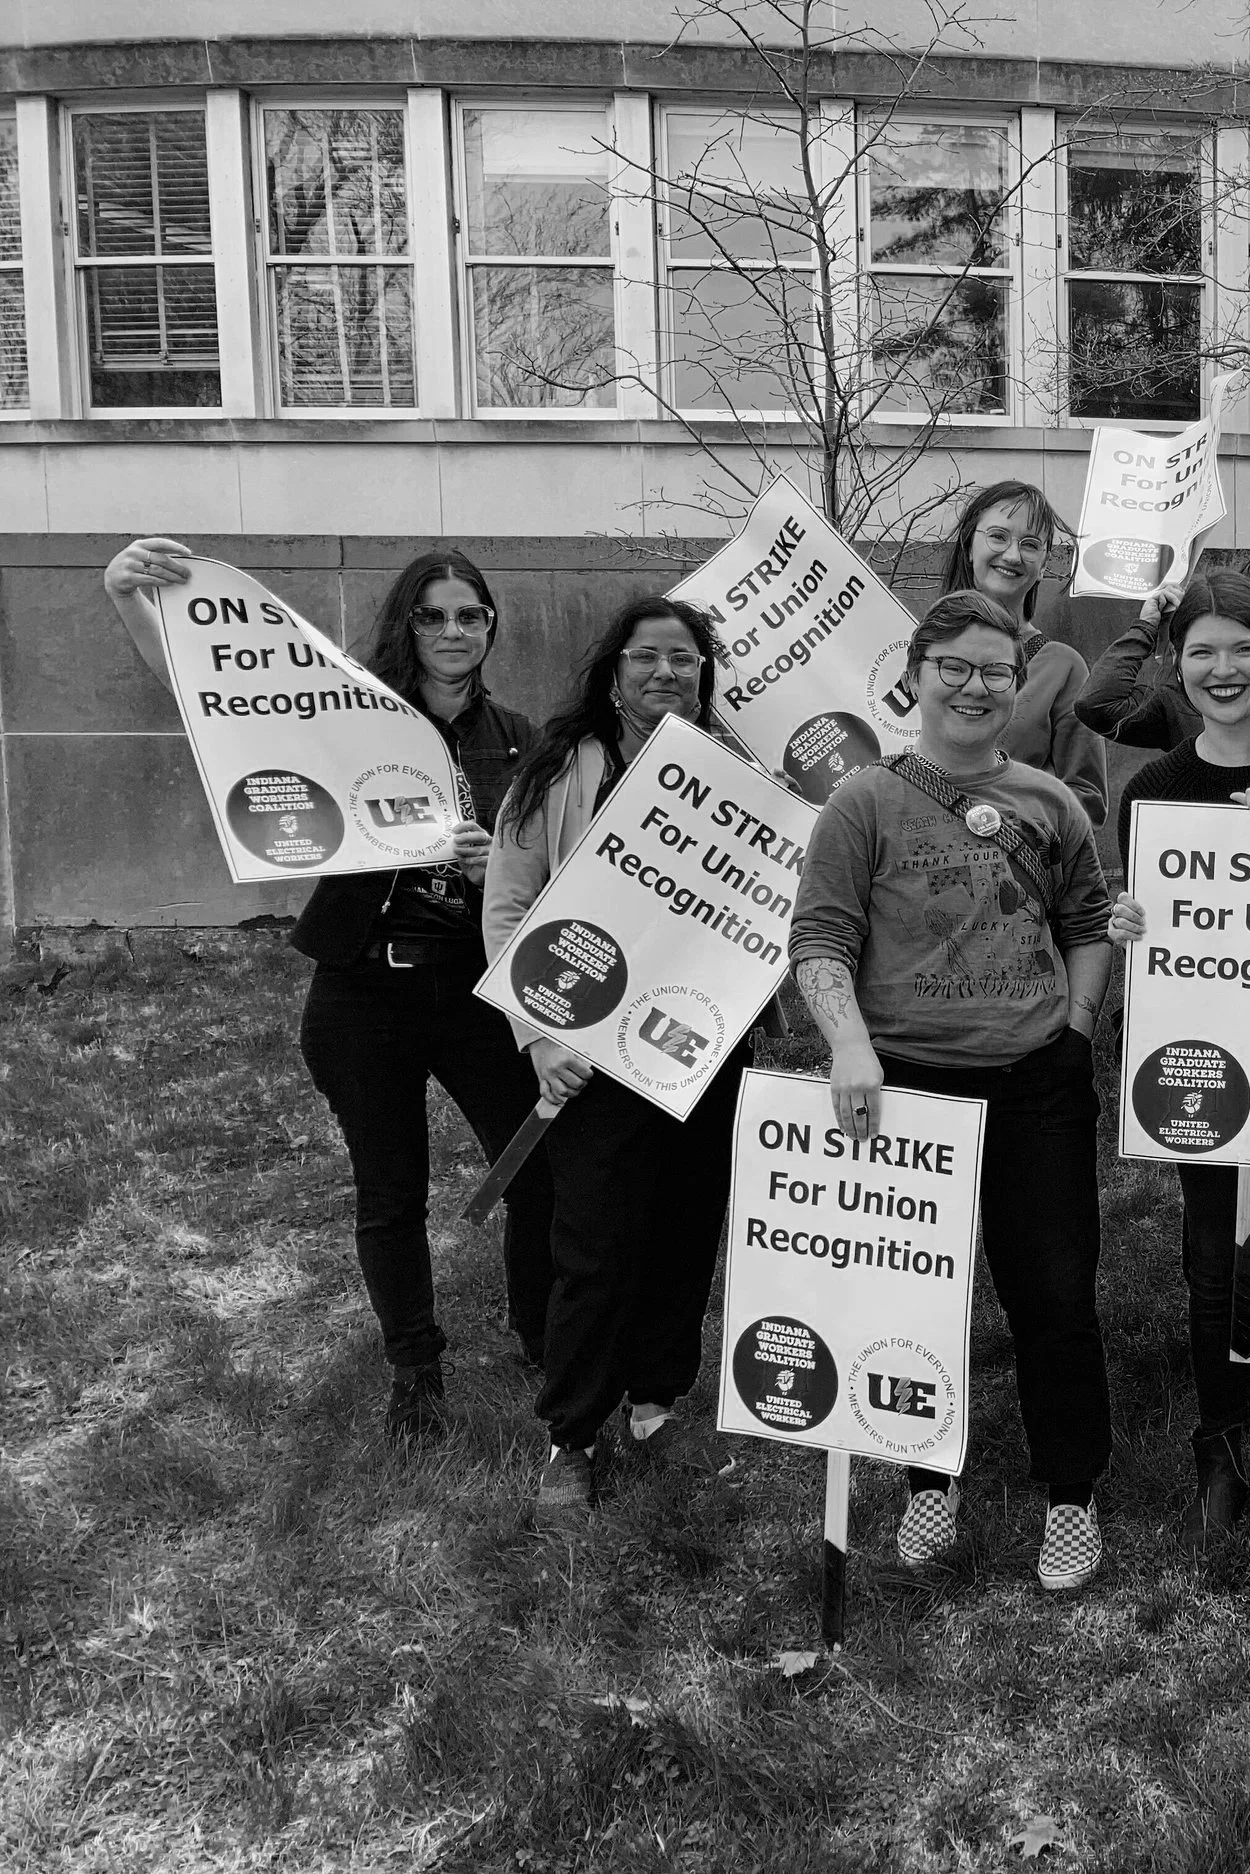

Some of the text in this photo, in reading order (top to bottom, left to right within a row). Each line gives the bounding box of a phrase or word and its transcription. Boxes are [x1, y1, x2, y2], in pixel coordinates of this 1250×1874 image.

[1112, 432, 1208, 470] ON STR
[1100, 481, 1198, 513] Recogn
[1120, 474, 1168, 491] For
[725, 515, 806, 612] STRIKE
[760, 559, 828, 630] Union
[187, 597, 248, 626] ON
[210, 643, 276, 672] For
[723, 574, 866, 712] Recognition
[866, 648, 890, 718] THE UNION FOR
[197, 684, 419, 720] Recognition
[789, 716, 829, 750] INDIANA
[791, 719, 838, 758] GRADUATE
[798, 726, 841, 762] WORKERS
[881, 720, 922, 738] MEMBER
[802, 730, 848, 772] COALITION
[244, 784, 309, 794] GRADUATE
[246, 776, 302, 786] INDIANA
[349, 764, 448, 810] THE UNION FOR EVERYONE
[832, 765, 861, 788] UNITED
[248, 793, 309, 803] WORKERS
[248, 802, 316, 812] COALITION
[658, 762, 806, 878] ON STRIK
[265, 846, 326, 856] ELECTRICAL
[354, 819, 447, 858] MEMBERS RUN THIS
[274, 854, 322, 862] WORKERS
[640, 806, 793, 920] For Union
[902, 851, 999, 870] THANK YOUR
[1158, 848, 1216, 880] ON
[594, 832, 784, 966] Recognition
[1172, 899, 1234, 930] For
[570, 921, 617, 956] INDIANA
[960, 921, 1010, 931] LUCKY
[548, 944, 608, 983] COALITION
[558, 936, 610, 973] WORKERS
[560, 928, 618, 967] GRADUATE
[522, 986, 576, 1022] ELECTRICAL
[524, 996, 568, 1026] WORKERS
[538, 984, 572, 1009] UNITED
[629, 985, 726, 1058] THE UNION FOR EVERYONE
[617, 1016, 710, 1092] MEMBERS RUN THIS UNION
[638, 1006, 710, 1070] UE
[1166, 1047, 1222, 1058] INDIANA
[1160, 1056, 1227, 1069] GRADUATE
[1162, 1066, 1224, 1079] WORKERS
[1158, 1076, 1227, 1089] COALITION
[758, 1118, 811, 1154] ON
[1158, 1127, 1220, 1138] ELECTRICAL
[1170, 1119, 1210, 1129] UNITED
[1164, 1136, 1214, 1146] WORKERS
[768, 1170, 938, 1225] For Union
[746, 1217, 956, 1280] Recognition
[756, 1330, 816, 1350] GRADUATE
[761, 1321, 811, 1338] INDIANA
[754, 1350, 816, 1370] COALITION
[758, 1340, 813, 1359] WORKERS
[848, 1338, 956, 1399] THE UNION FOR EVERYONE
[755, 1402, 813, 1419] ELECTRICAL
[766, 1395, 802, 1408] UNITED
[866, 1372, 936, 1420] UE
[760, 1411, 808, 1426] WORKERS
[848, 1392, 956, 1454] MEMBERS RUN THIS UNION
